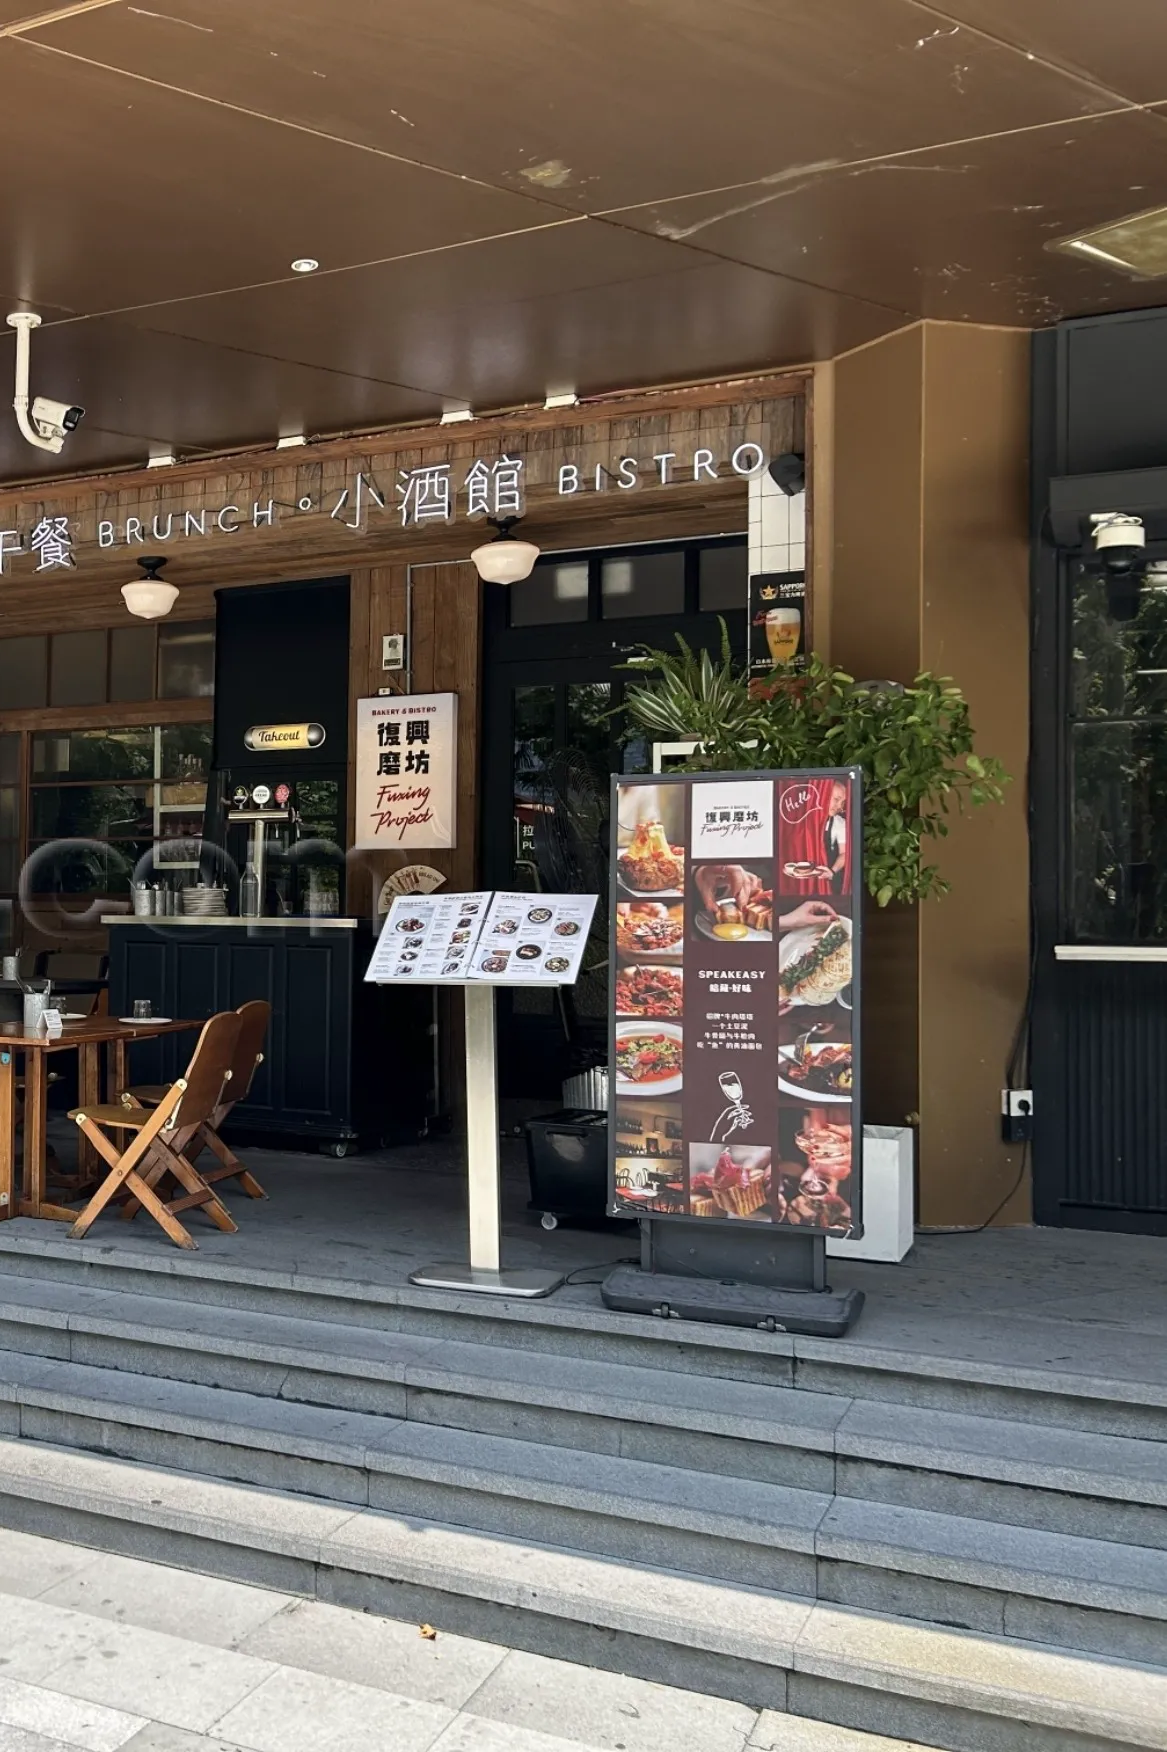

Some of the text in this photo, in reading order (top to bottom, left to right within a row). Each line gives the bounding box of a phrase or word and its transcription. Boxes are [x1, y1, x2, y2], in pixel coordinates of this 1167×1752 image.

[99, 499, 274, 548] BRUNCH
[331, 454, 524, 528] 小酒館
[559, 442, 764, 495] BISTRO
[371, 708, 400, 717] BAKERY
[408, 706, 437, 715] BISTRO
[258, 730, 301, 743] Takeout
[377, 720, 430, 747] 復興
[376, 749, 430, 776] 磨坊
[376, 783, 431, 811] Fuxing
[785, 790, 811, 813] Hello
[370, 807, 434, 841] Project
[522, 824, 535, 837] 拉
[700, 822, 763, 838] Fuxing Project
[698, 969, 766, 979] SPEAKEASY
